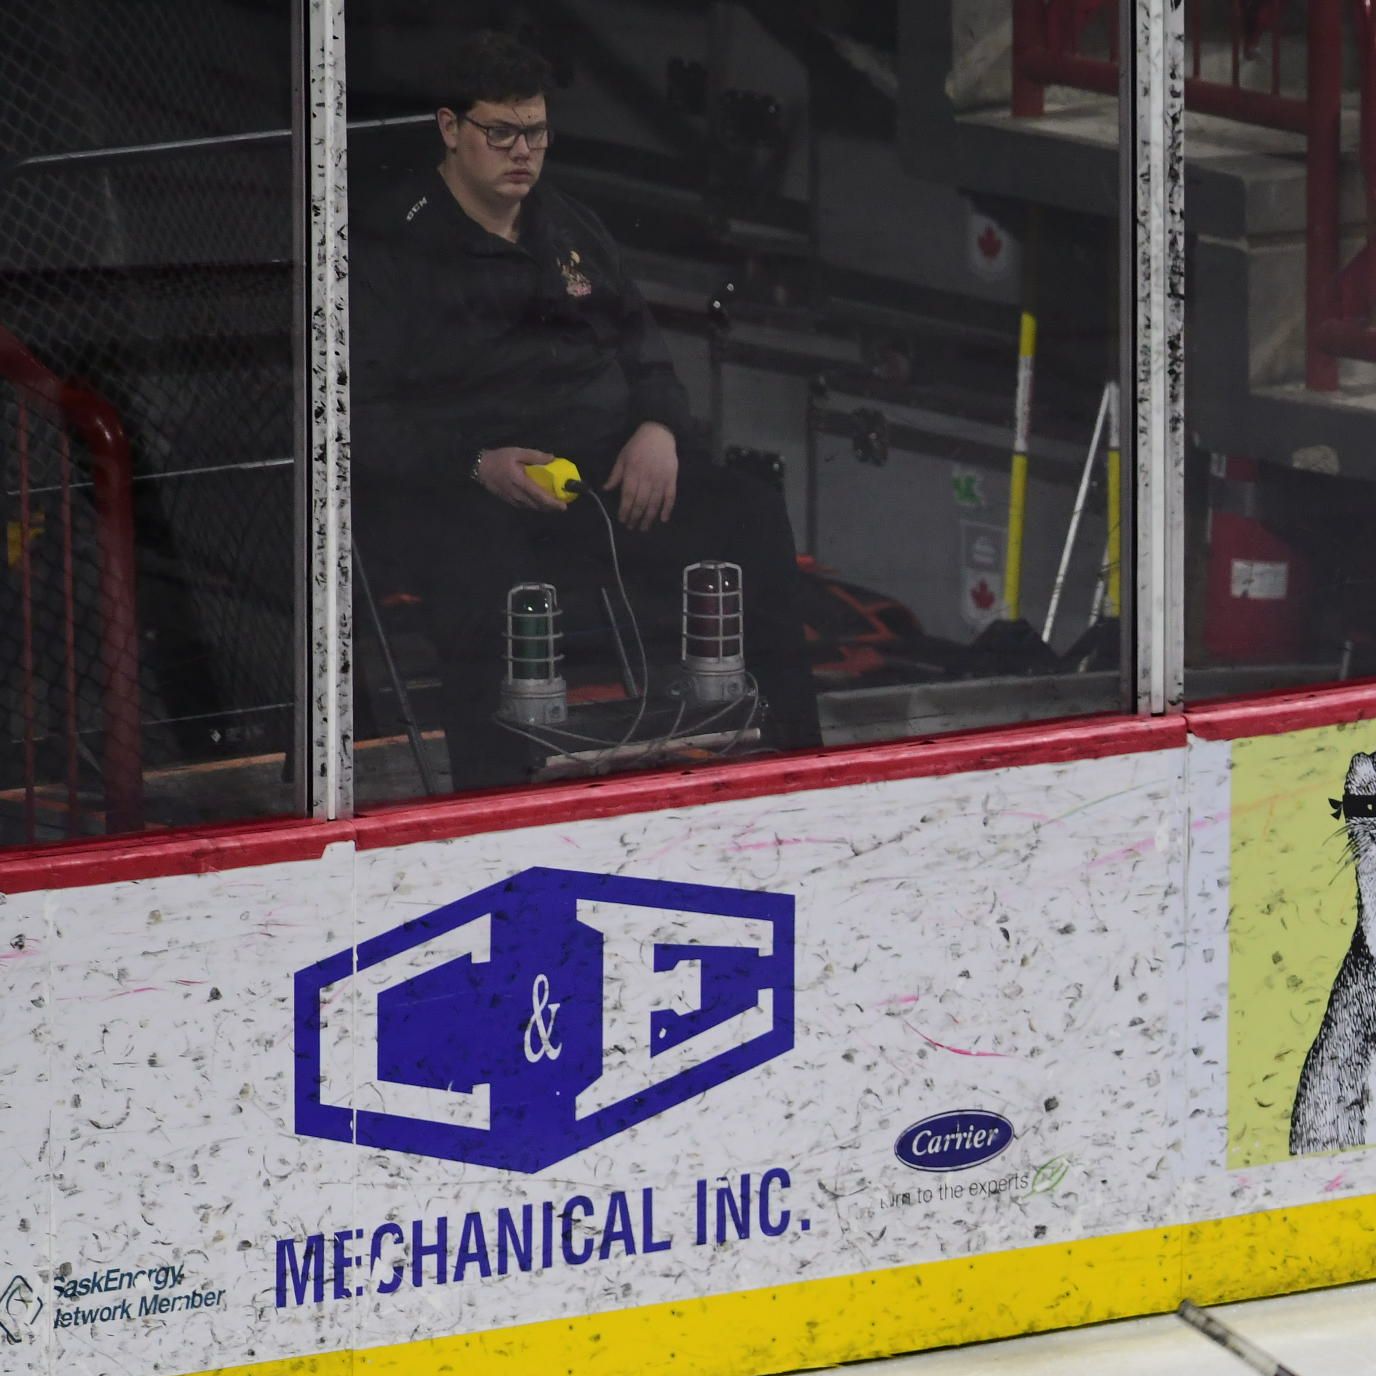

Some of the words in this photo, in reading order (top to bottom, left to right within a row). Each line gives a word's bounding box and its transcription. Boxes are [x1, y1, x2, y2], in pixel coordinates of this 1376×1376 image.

[524, 974, 563, 1064] &
[912, 1124, 999, 1156] Carrier
[939, 1183, 964, 1200] the
[968, 1172, 1029, 1198] experts
[274, 1187, 672, 1309] MECHANICAL
[696, 1166, 812, 1246] INC.
[138, 1288, 226, 1317] Member
